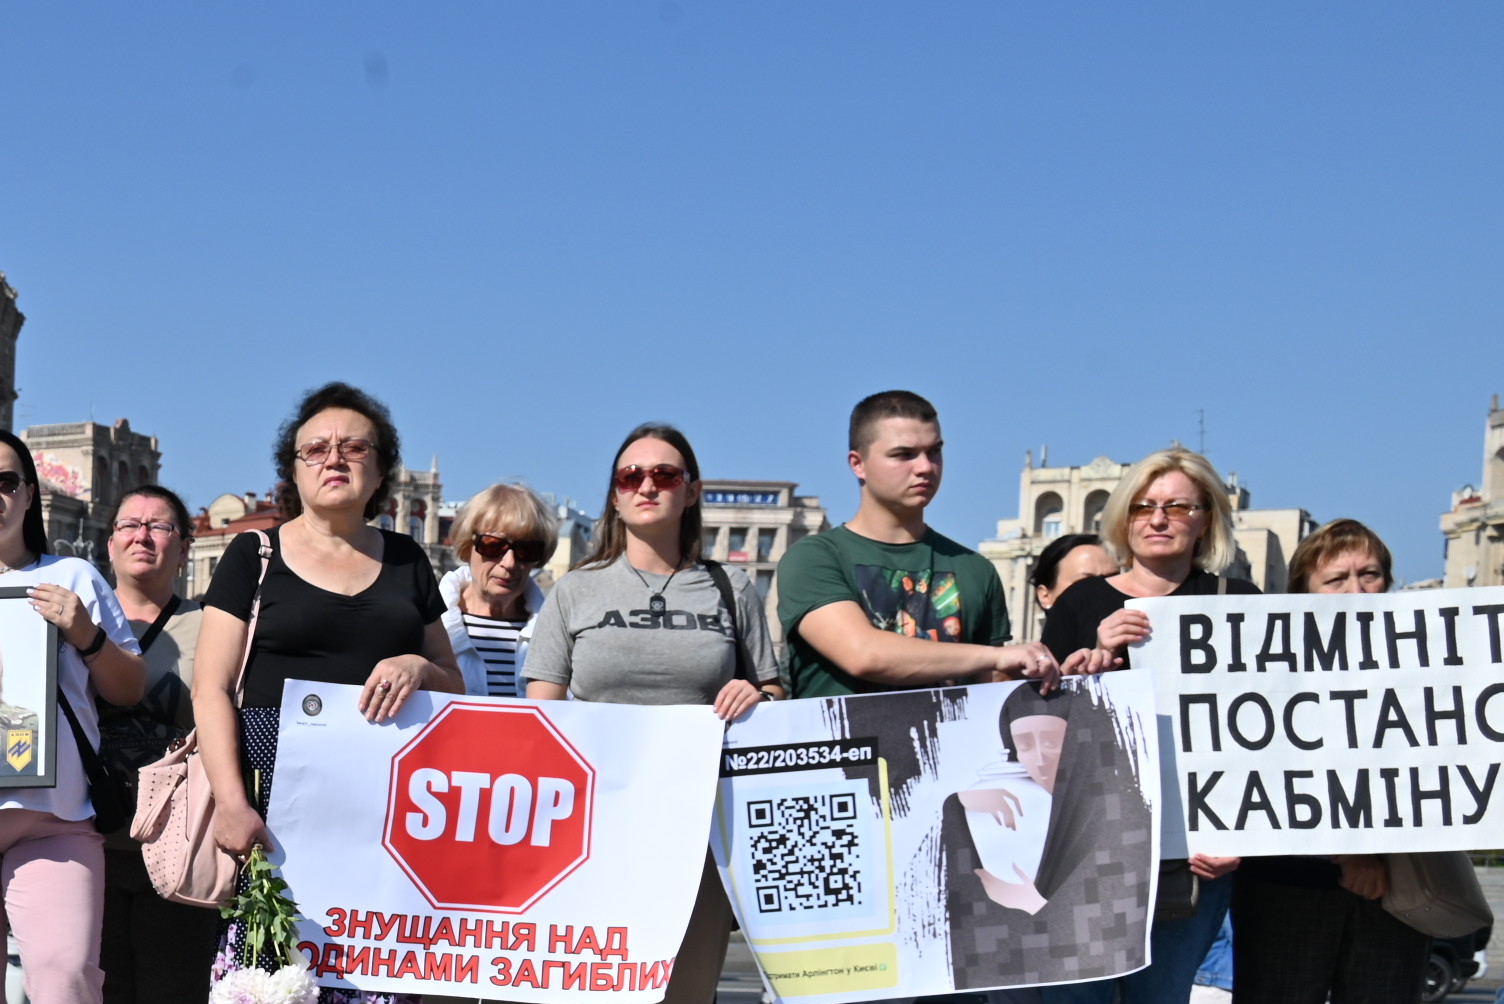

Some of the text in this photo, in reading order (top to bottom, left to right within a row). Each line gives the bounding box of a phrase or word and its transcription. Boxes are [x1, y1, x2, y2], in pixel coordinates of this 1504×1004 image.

[598, 609, 727, 634] АЗОВ
[1179, 604, 1504, 674] ВІДМІНІТ
[1179, 682, 1504, 752] ПОСТАНО
[725, 745, 872, 771] №22/203534-еп
[405, 767, 576, 847] STOP
[1187, 762, 1501, 831] КАБМІНУ
[323, 907, 629, 961] ЗНУЩАННЯ НАД
[296, 940, 676, 991] ОДИНАМИ ЗАГИБЛИХ
